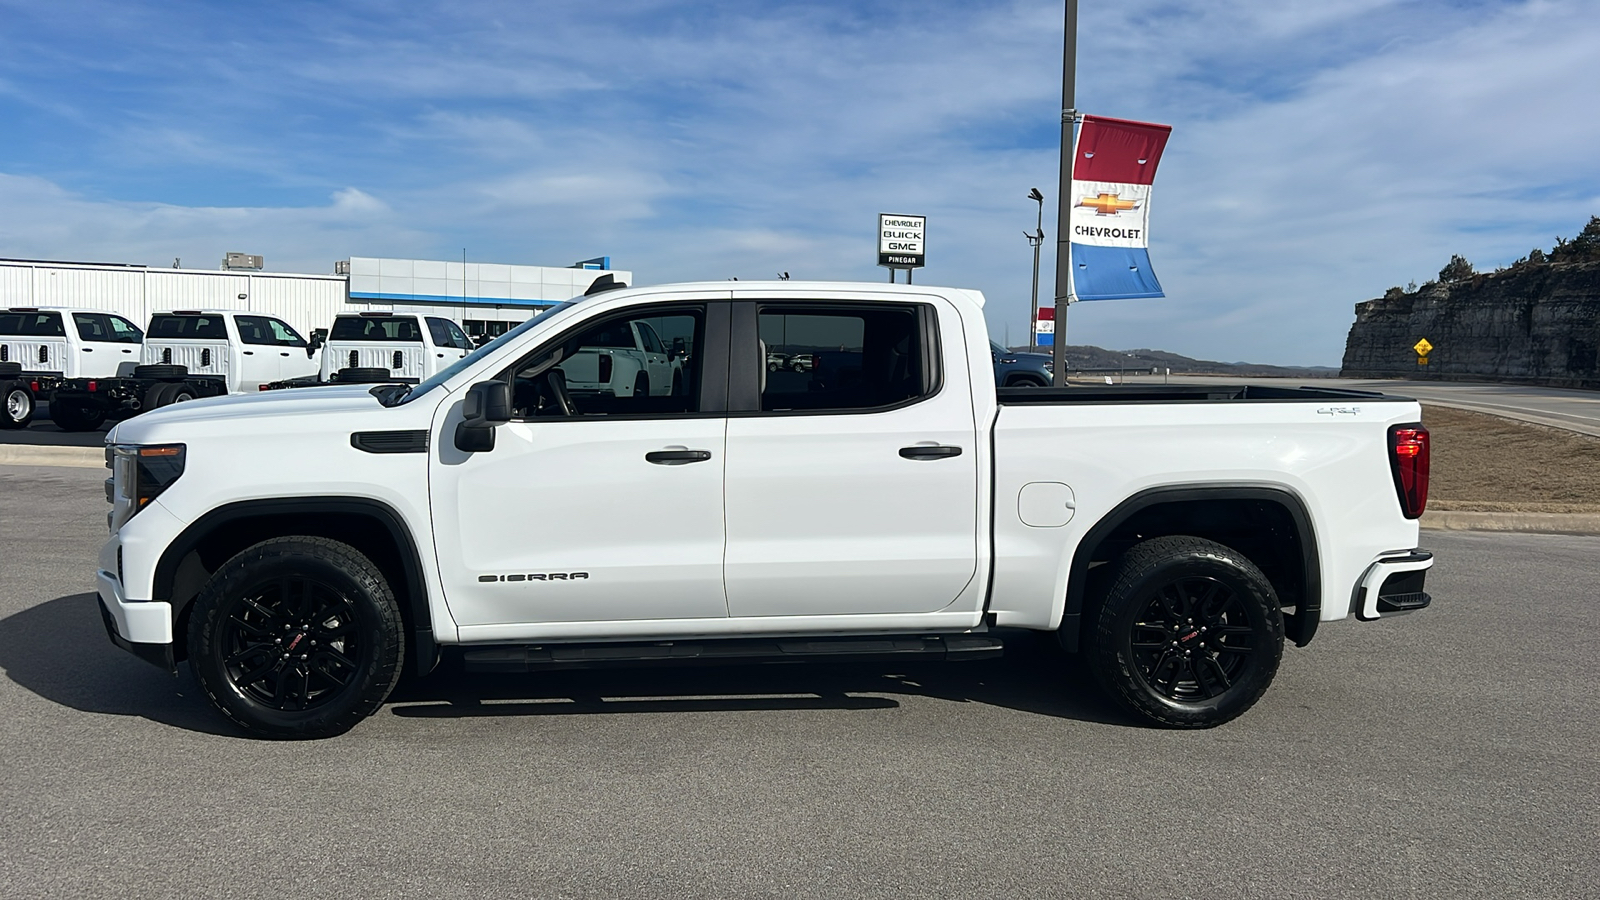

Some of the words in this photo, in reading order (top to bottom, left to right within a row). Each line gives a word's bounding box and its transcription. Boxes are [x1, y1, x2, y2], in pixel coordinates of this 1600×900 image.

[884, 219, 922, 228] CHEVROLET
[883, 231, 921, 239] BUICK
[1075, 225, 1141, 239] CHEVROLET
[888, 242, 917, 251] GMC
[888, 256, 916, 264] PINEGAR
[478, 572, 589, 582] SIERRA
